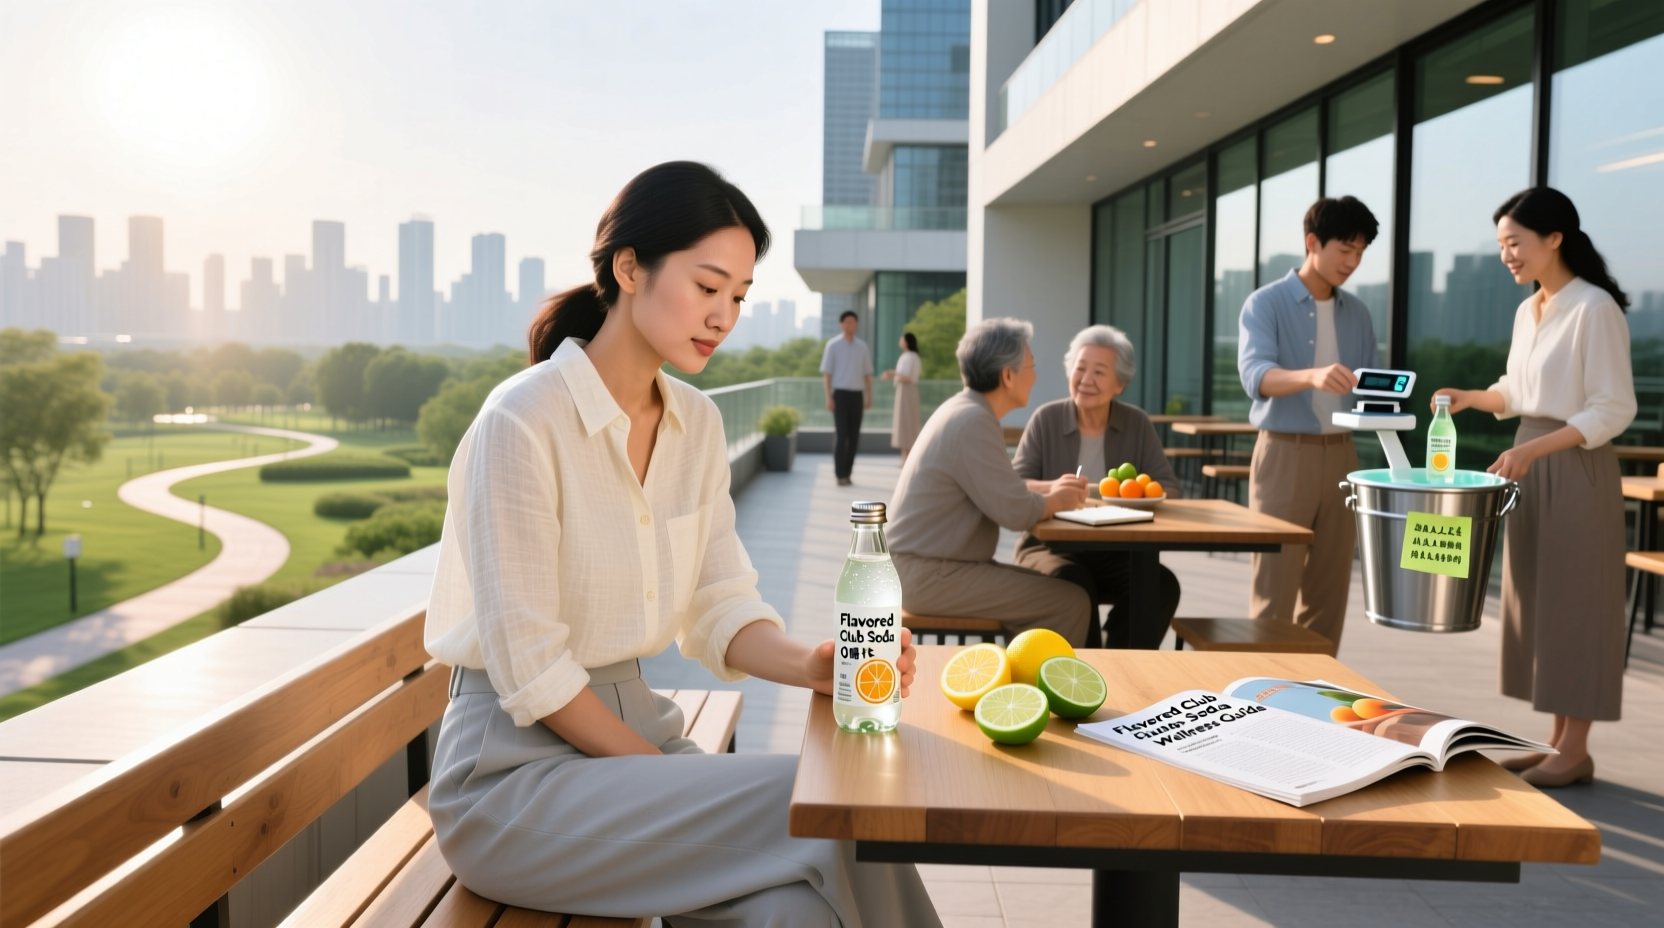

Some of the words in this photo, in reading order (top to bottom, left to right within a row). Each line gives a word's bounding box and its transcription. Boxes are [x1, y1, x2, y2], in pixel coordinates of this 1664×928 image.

[840, 612, 894, 628] Flavored
[840, 629, 865, 643] Club
[867, 629, 895, 643] Soda
